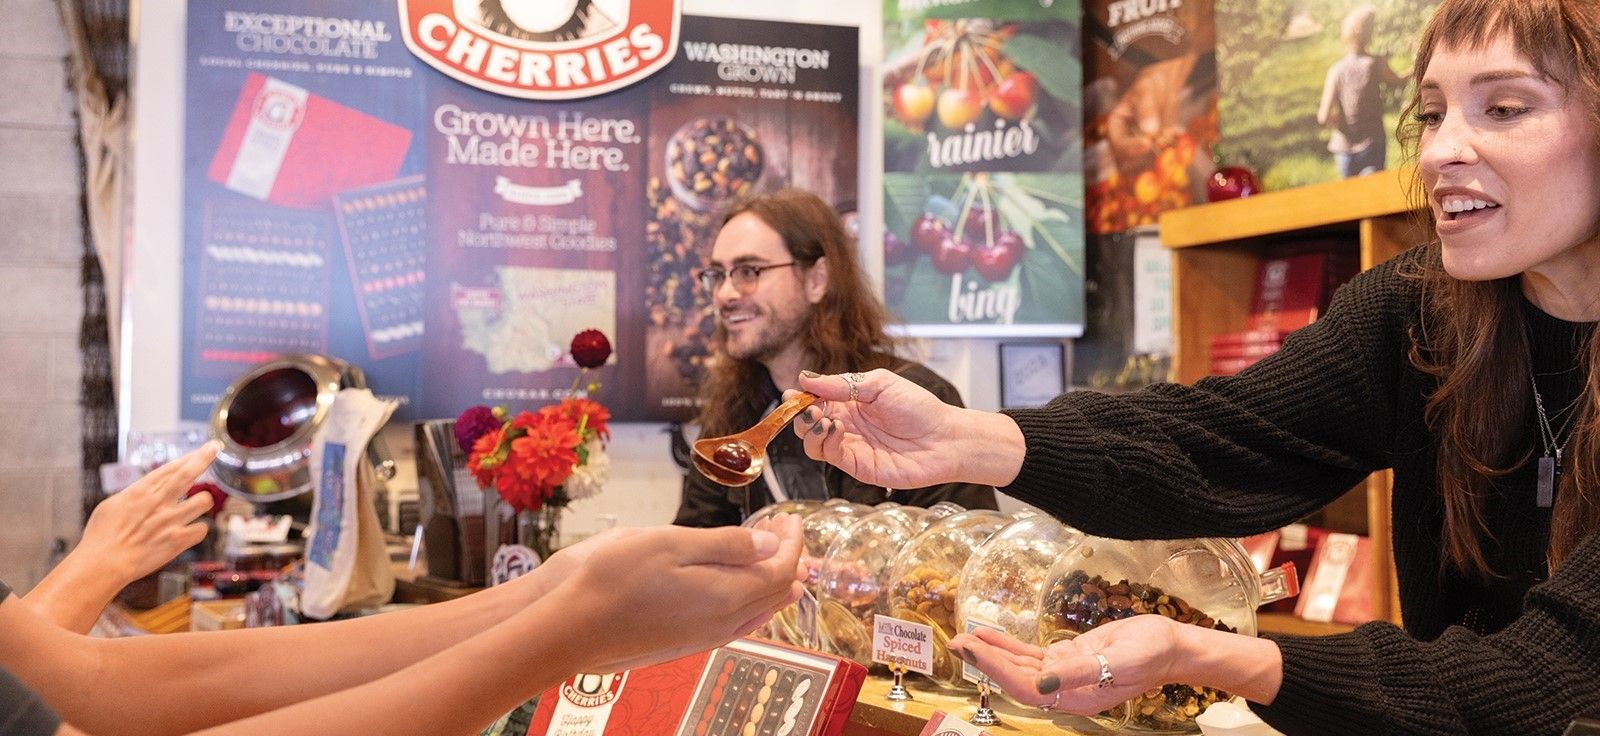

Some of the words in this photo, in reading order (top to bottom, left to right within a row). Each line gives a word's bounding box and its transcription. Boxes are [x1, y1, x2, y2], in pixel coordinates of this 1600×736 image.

[224, 11, 392, 42] EXCEPTIONAL
[236, 32, 378, 59] CHOCOLATE
[417, 12, 664, 88] CHERRIES
[683, 41, 830, 70] WASHINGTON
[717, 62, 797, 84] GROWN
[434, 104, 550, 139] Grown
[556, 111, 641, 144] Here.
[446, 134, 540, 167] Made
[545, 139, 630, 171] Here.
[926, 118, 1040, 168] rainier
[479, 213, 519, 232] Pure
[538, 215, 597, 235] Simple
[457, 229, 548, 249] Northwest
[549, 233, 617, 251] Goodies
[949, 272, 1021, 325] bing
[883, 635, 921, 654] Spiced
[894, 624, 926, 642] Chocolate
[877, 649, 927, 670] Hazenuts
[564, 685, 614, 707] CHERRIES
